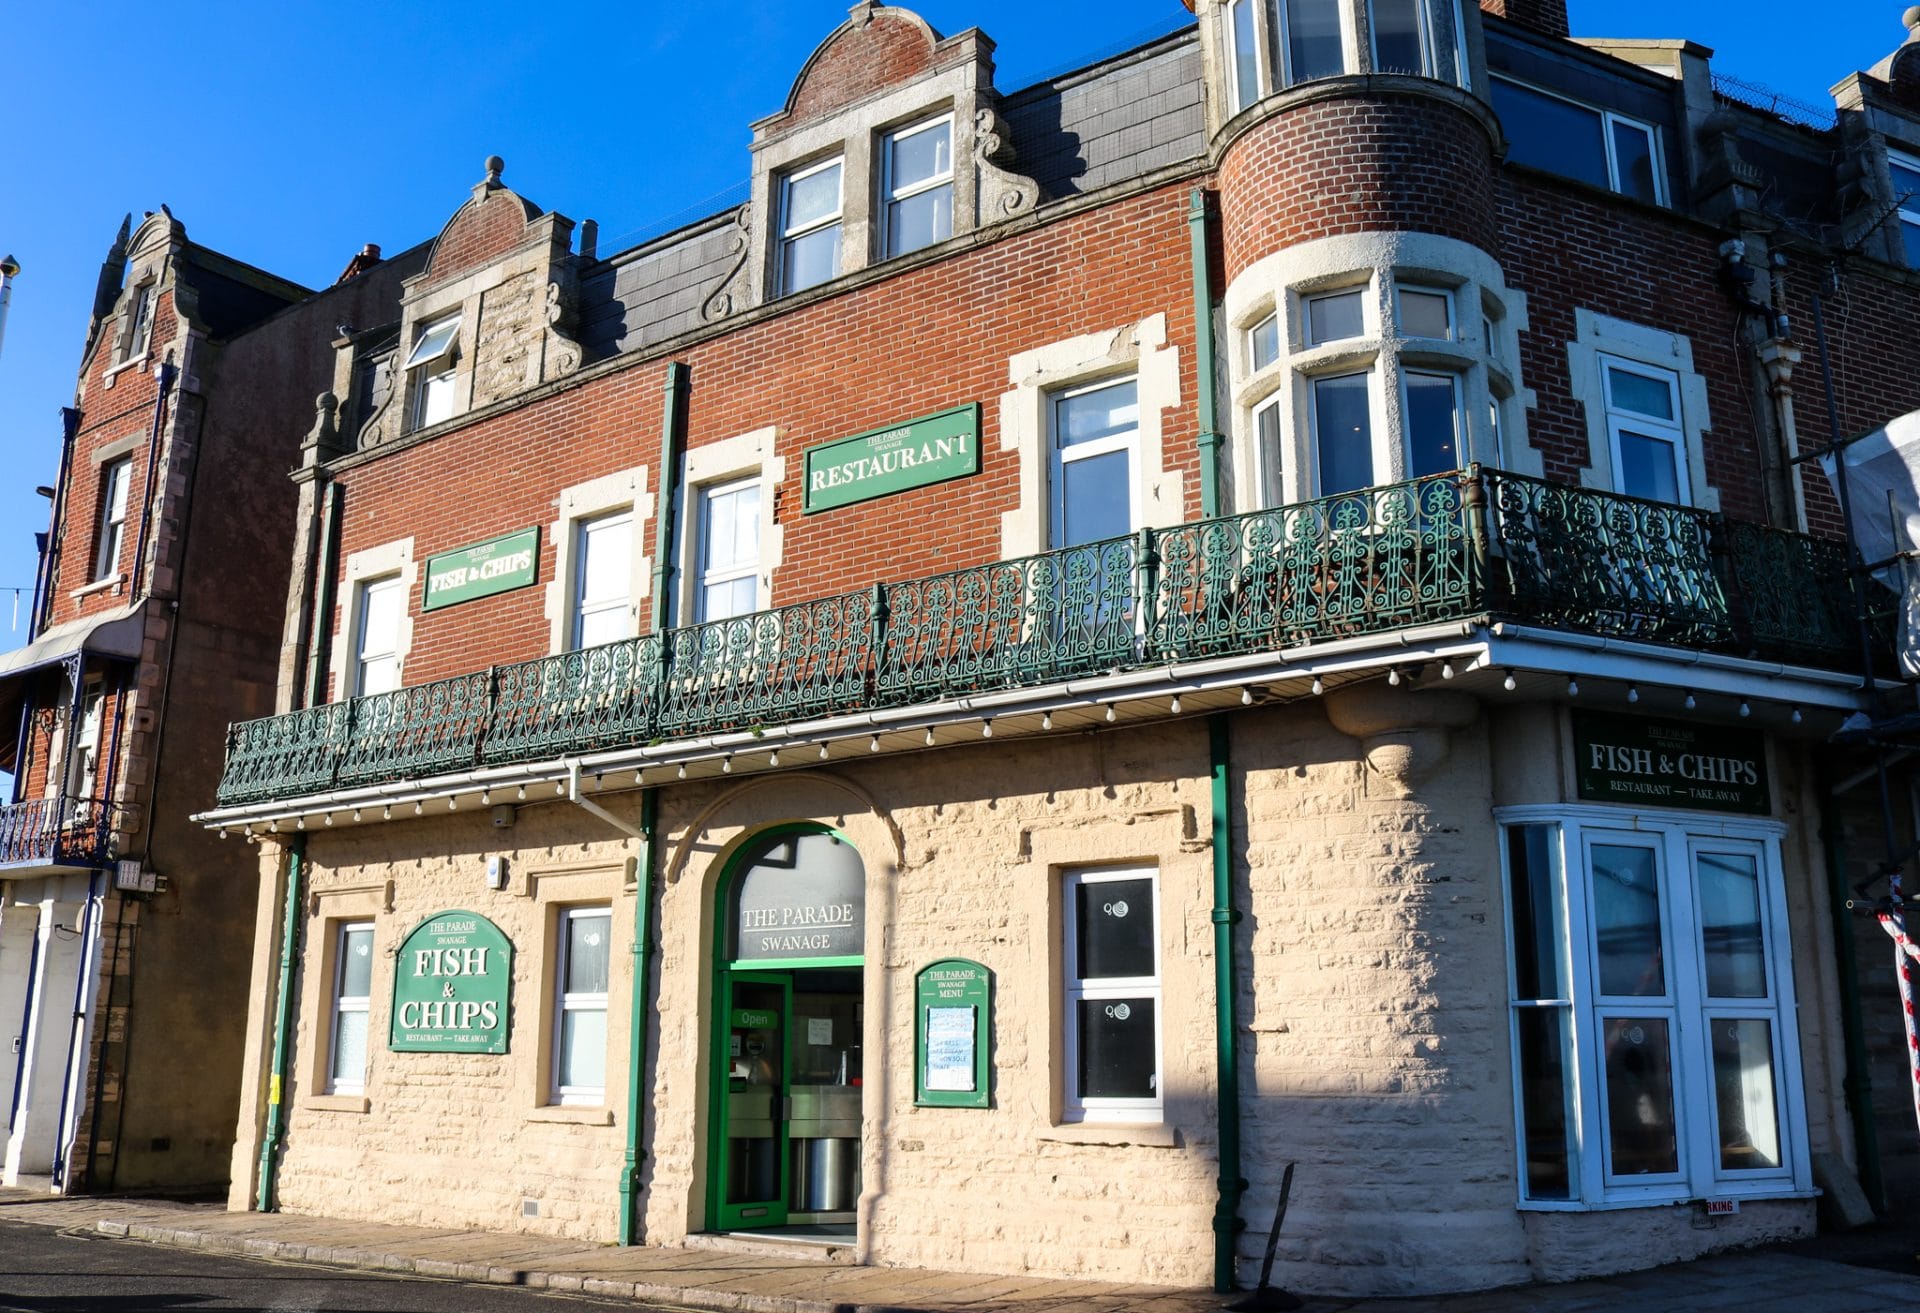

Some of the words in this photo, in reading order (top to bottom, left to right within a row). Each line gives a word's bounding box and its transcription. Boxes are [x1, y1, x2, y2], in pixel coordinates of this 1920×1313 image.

[867, 435, 882, 446] THE
[883, 427, 911, 441] PARADE
[810, 433, 972, 492] RESTAURANT
[430, 567, 468, 593] FISH
[468, 567, 480, 582] &
[480, 549, 532, 580] CHIPS
[1589, 743, 1654, 775] FISH
[1659, 754, 1675, 775] &
[1678, 753, 1758, 786] CHIPS
[1610, 780, 1671, 796] RESTAURANT
[1689, 788, 1714, 800] TAKE
[1715, 789, 1740, 802] AWAY
[743, 909, 778, 928] THE
[783, 904, 854, 925] PARADE
[431, 922, 444, 933] THE
[446, 920, 477, 932] PARADE
[437, 935, 467, 945] SWANAGE
[761, 934, 831, 952] SWANAGE
[413, 947, 490, 977] FISH
[929, 971, 945, 979] THE
[946, 969, 976, 979] PARADE
[442, 981, 455, 998] &
[939, 989, 963, 998] MENU
[399, 1000, 499, 1030] CHIPS
[742, 1012, 768, 1028] Open
[406, 1034, 443, 1042] RESTAURANT
